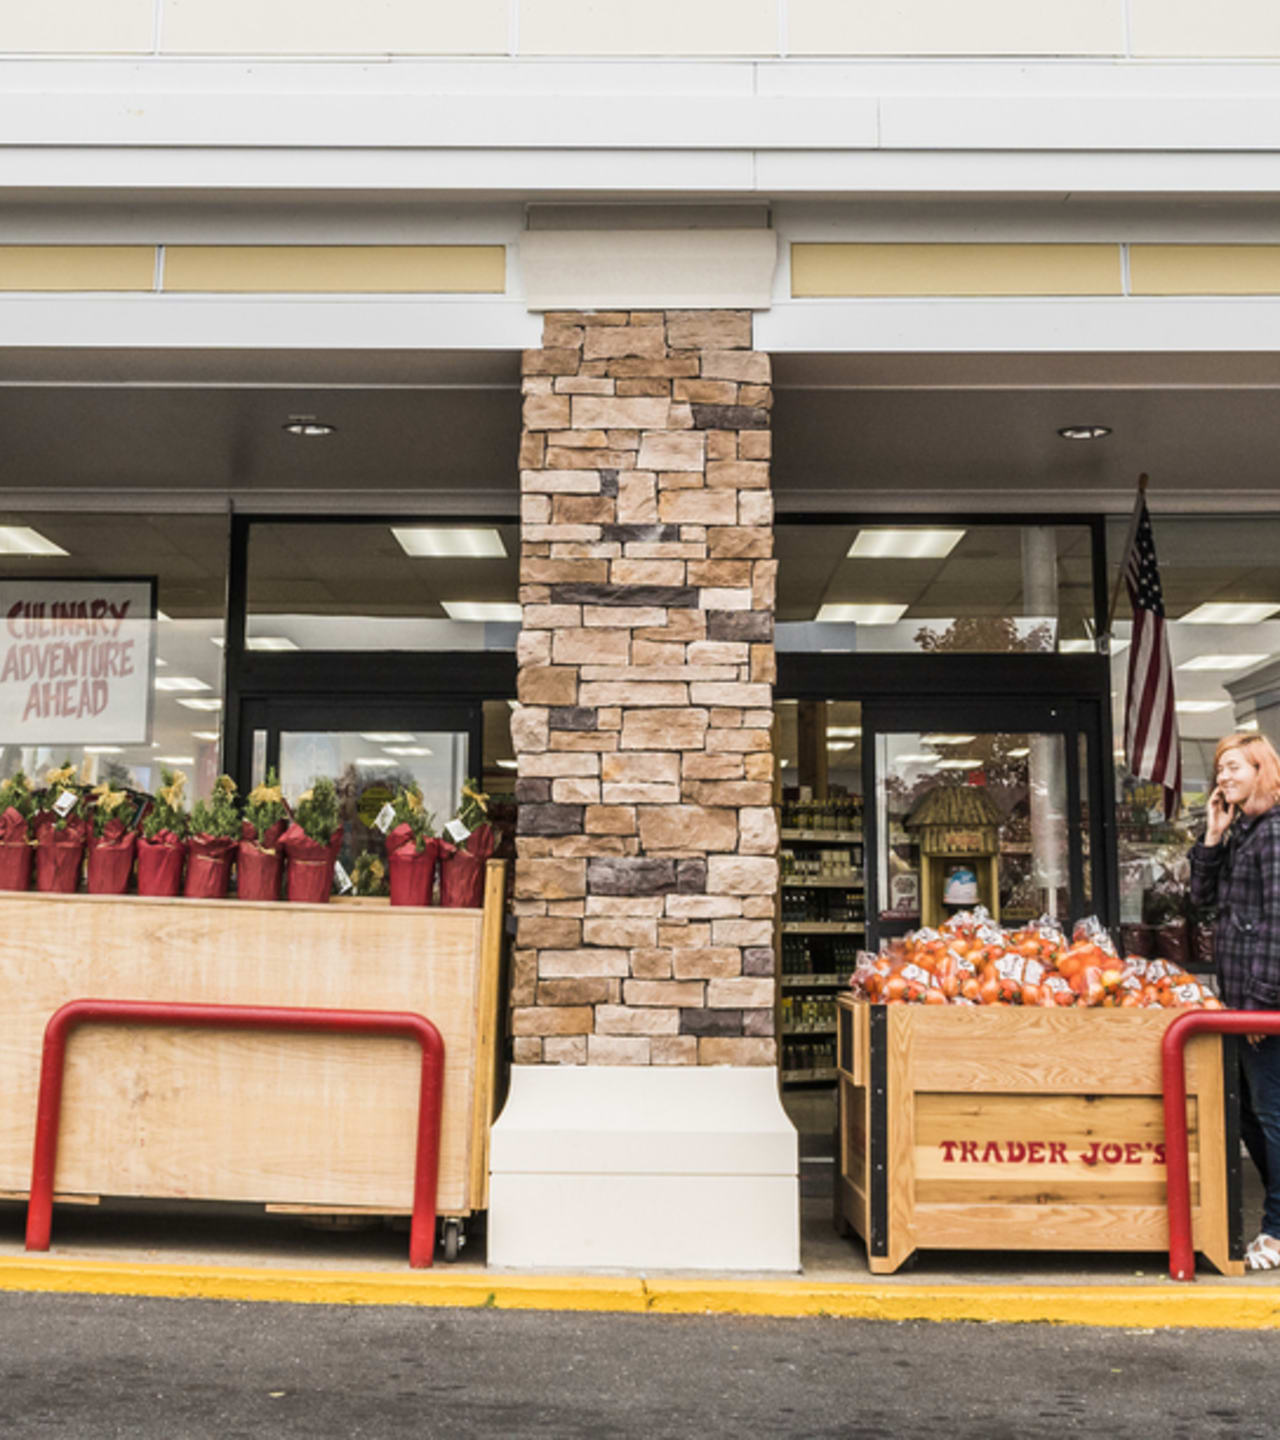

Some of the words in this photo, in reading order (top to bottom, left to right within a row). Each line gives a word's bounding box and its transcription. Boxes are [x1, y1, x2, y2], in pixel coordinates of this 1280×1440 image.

[6, 598, 132, 640] CULINARY
[0, 638, 136, 683] ADVENTURE
[21, 678, 110, 723] AHEAD
[939, 1140, 1069, 1164] TRADER
[1079, 1141, 1167, 1166] JOE'S
